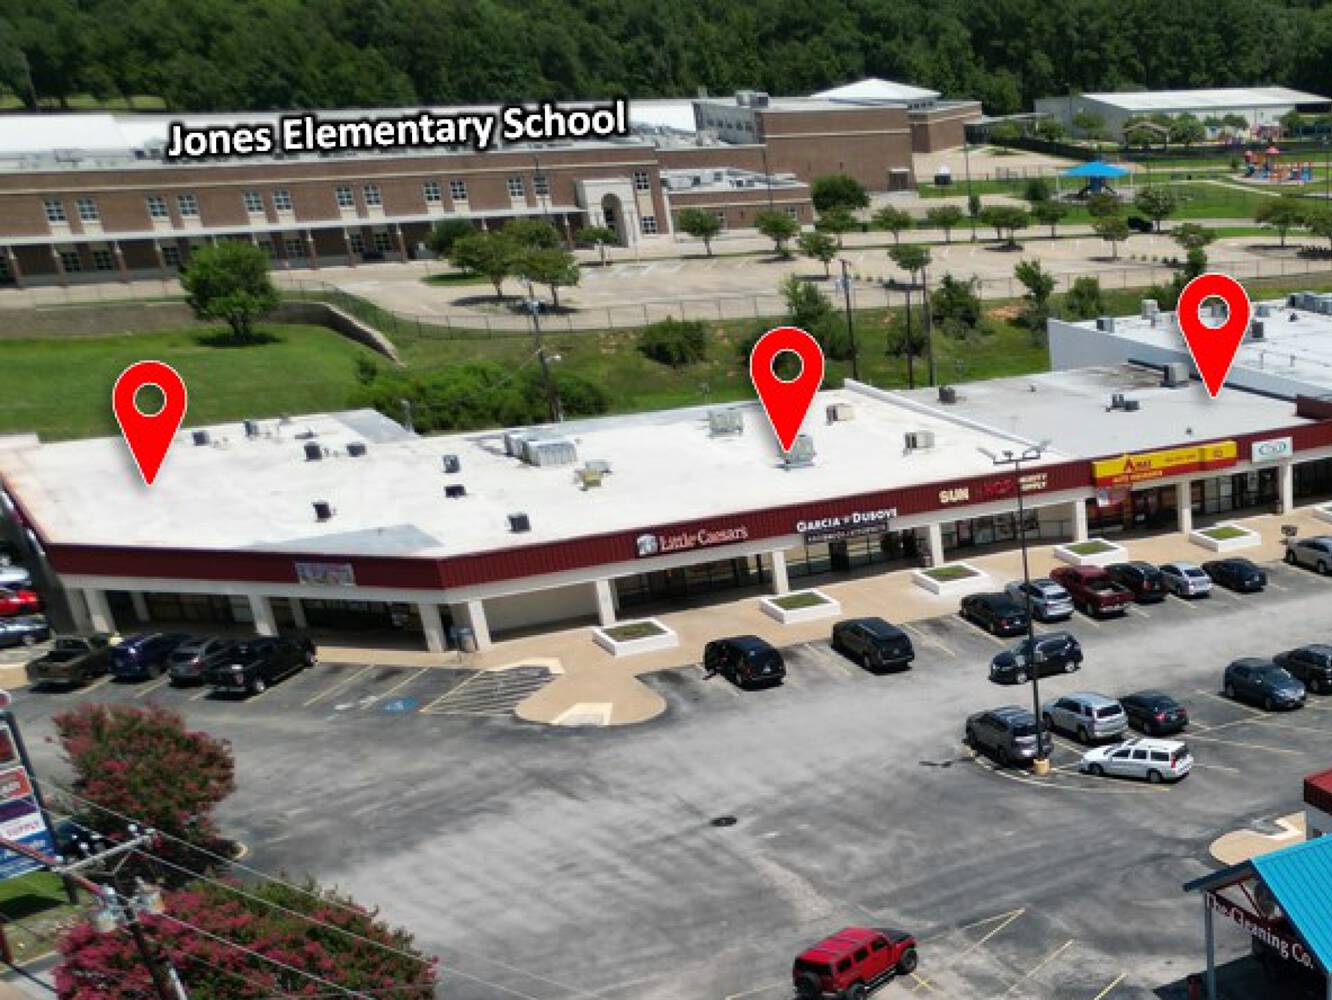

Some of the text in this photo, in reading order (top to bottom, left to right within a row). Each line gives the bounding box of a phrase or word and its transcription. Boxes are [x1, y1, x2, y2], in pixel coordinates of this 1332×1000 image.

[939, 486, 969, 504] SUN
[796, 516, 840, 532] GARCIA
[659, 531, 696, 552] Little
